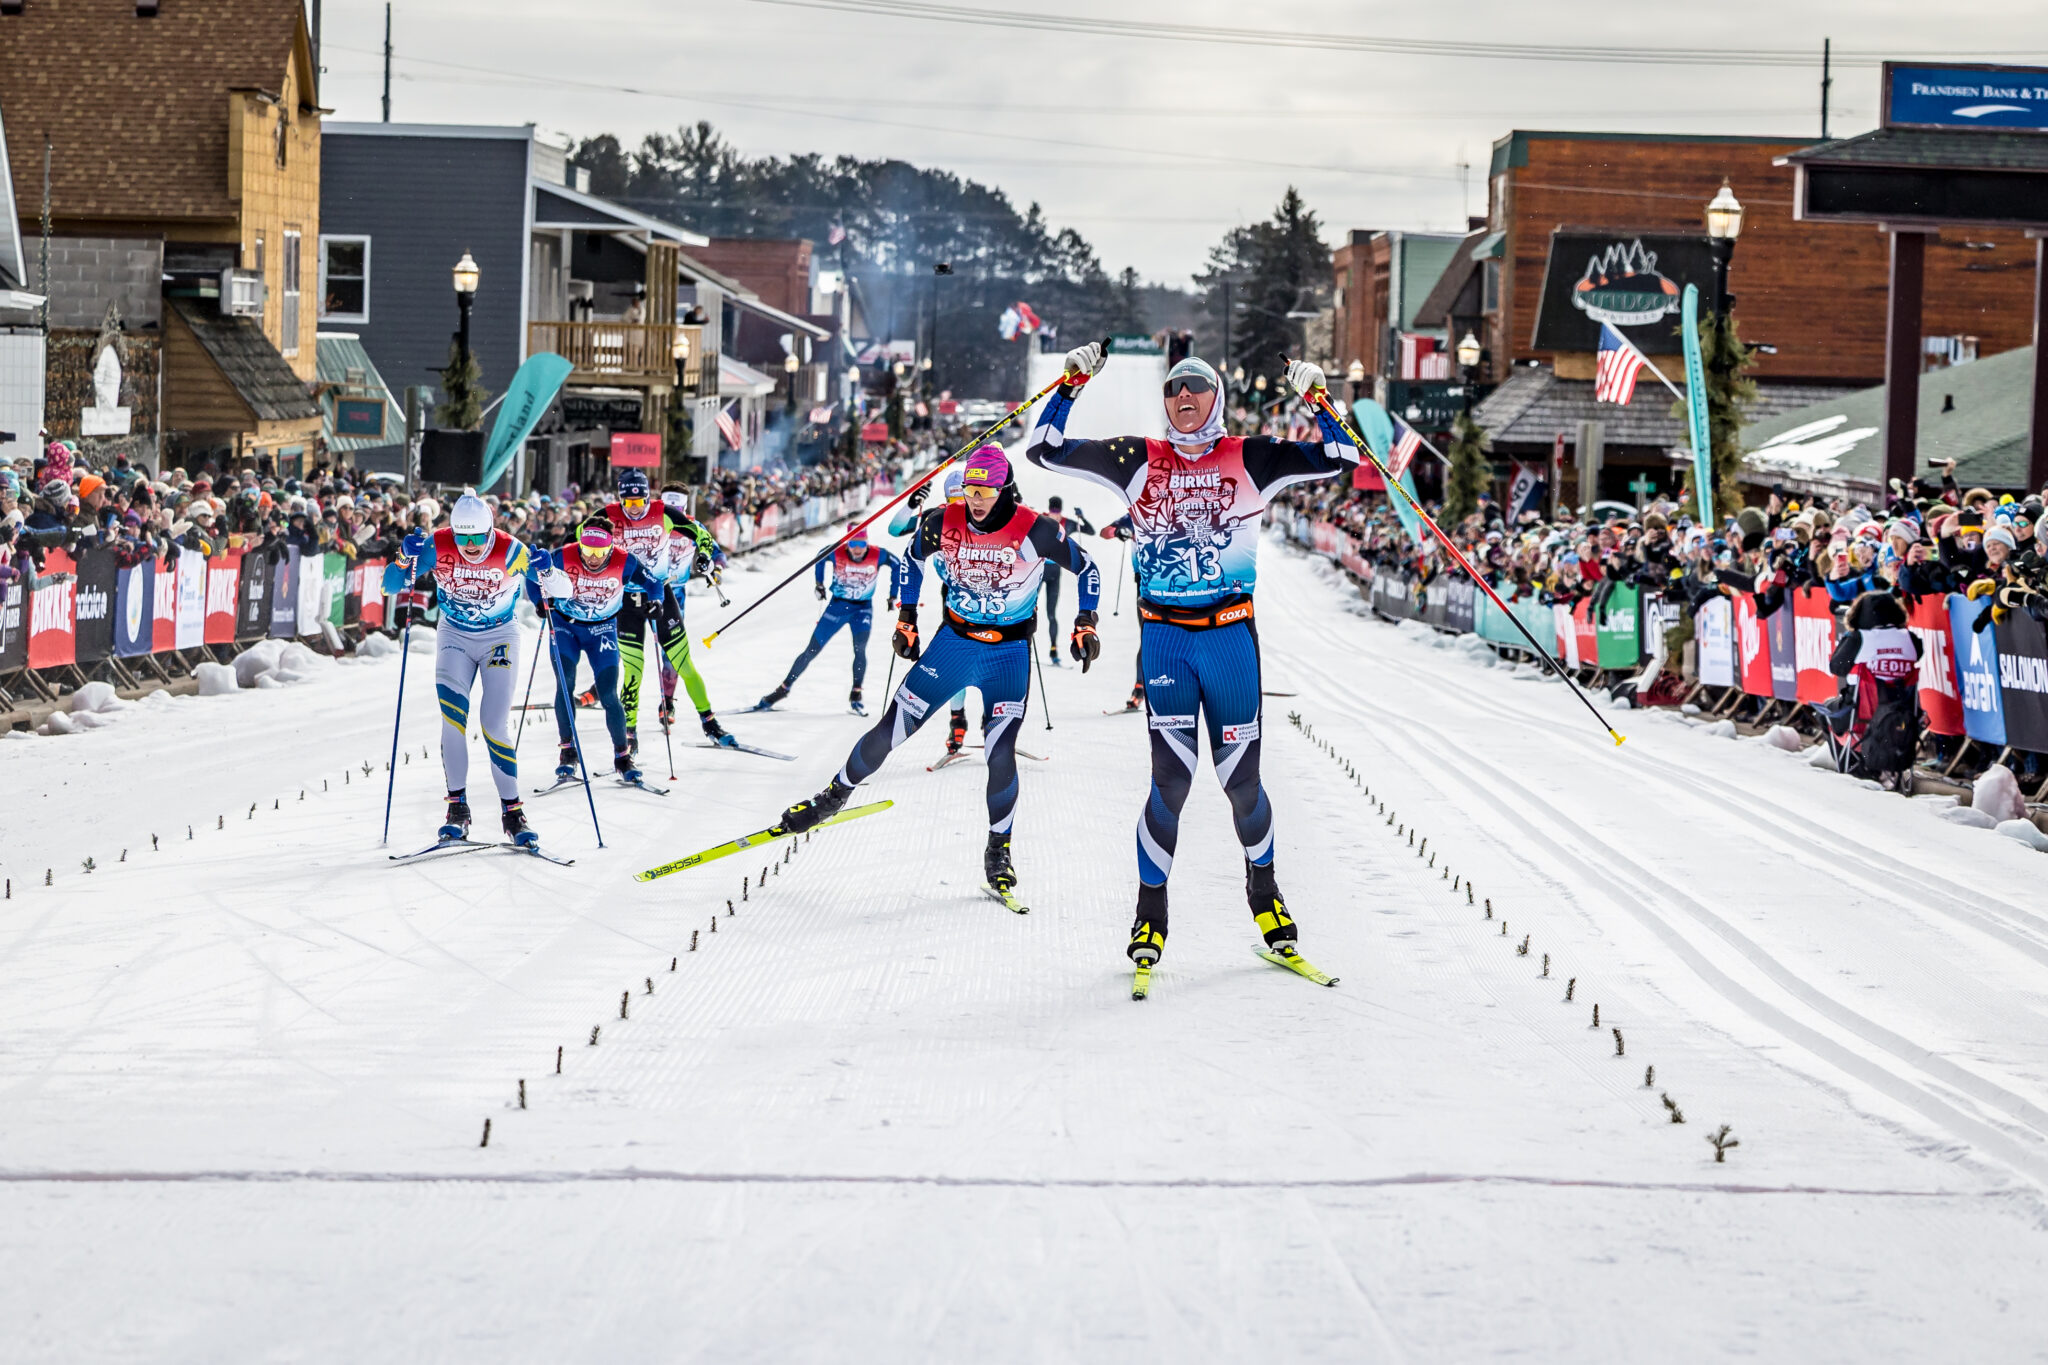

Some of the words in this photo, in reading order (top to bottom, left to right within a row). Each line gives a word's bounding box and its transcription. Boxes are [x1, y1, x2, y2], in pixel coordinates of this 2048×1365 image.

[1912, 82, 1979, 97] FRANDSEN
[1983, 85, 2018, 98] BANK
[2020, 88, 2032, 99] &
[1170, 473, 1222, 489] BIRKIE
[1174, 501, 1221, 511] PIONEER
[1181, 546, 1221, 583] 13
[1087, 569, 1100, 596] APU
[845, 588, 863, 599] 30
[31, 580, 73, 637] BIRKIE
[958, 592, 1006, 615] 215
[467, 607, 481, 622] 2
[1220, 608, 1248, 621] COXA
[1795, 616, 1834, 677] BIRKIE
[1868, 660, 1912, 672] MEDIA
[2000, 653, 2048, 693] SALOMON
[1151, 718, 1194, 728] ConocoPhillips
[655, 853, 702, 877] FISCHER
